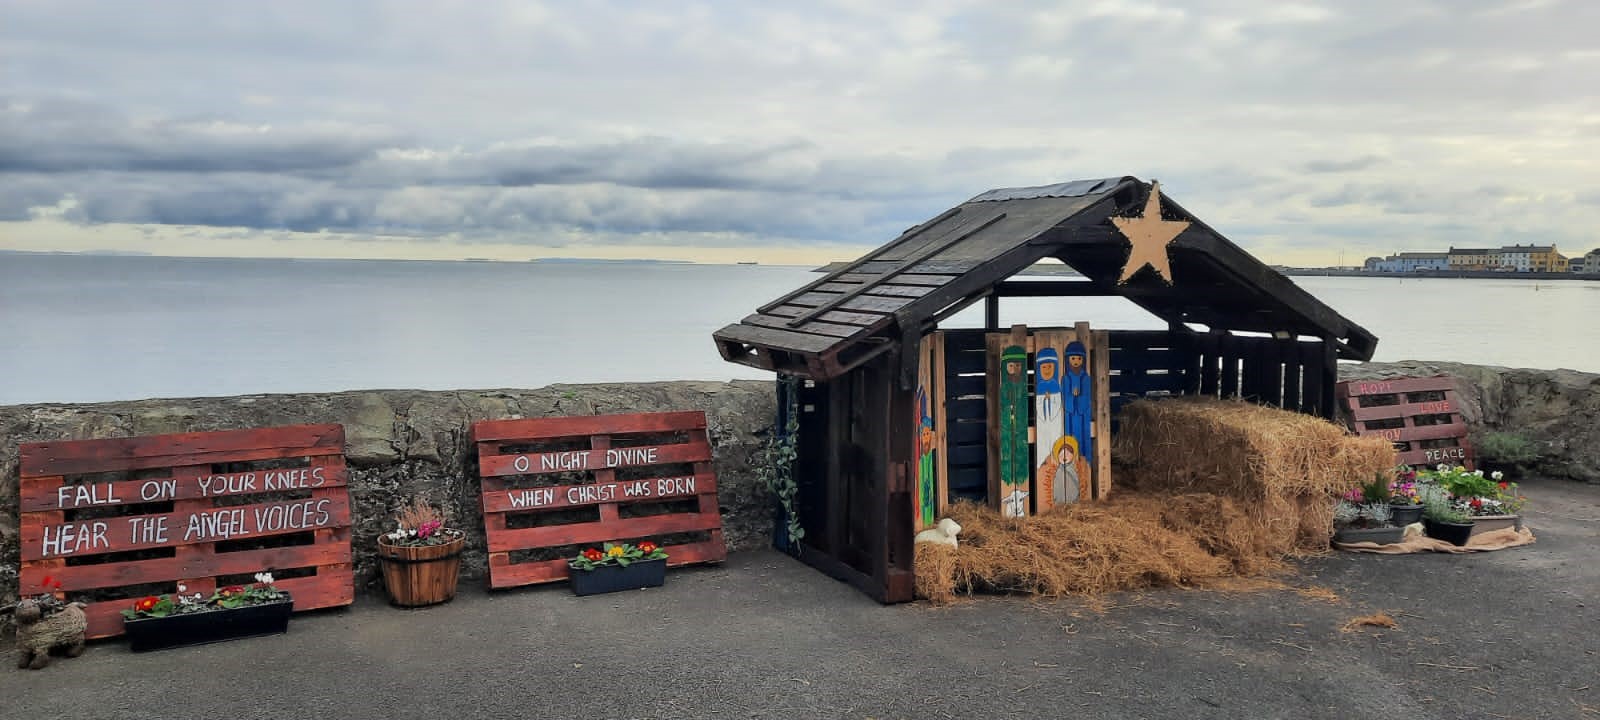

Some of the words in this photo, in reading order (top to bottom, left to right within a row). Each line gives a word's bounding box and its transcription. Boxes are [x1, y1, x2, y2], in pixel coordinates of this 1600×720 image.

[1420, 402, 1449, 413] LOVE
[514, 455, 529, 472] O
[541, 451, 590, 470] NIGHT
[607, 448, 658, 468] DIVINE
[1425, 448, 1465, 461] PEACE
[58, 483, 121, 508] FALL
[141, 479, 177, 501] ON
[198, 474, 256, 497] YOUR
[264, 467, 325, 491] KNEES
[508, 488, 553, 507] WHEN
[567, 484, 617, 504] CHRIST
[624, 481, 650, 497] WAS
[657, 476, 695, 495] BORN
[42, 523, 109, 556] HEAR
[129, 516, 168, 544] THE
[183, 509, 249, 541] ANGEL
[255, 500, 330, 532] VOICES
